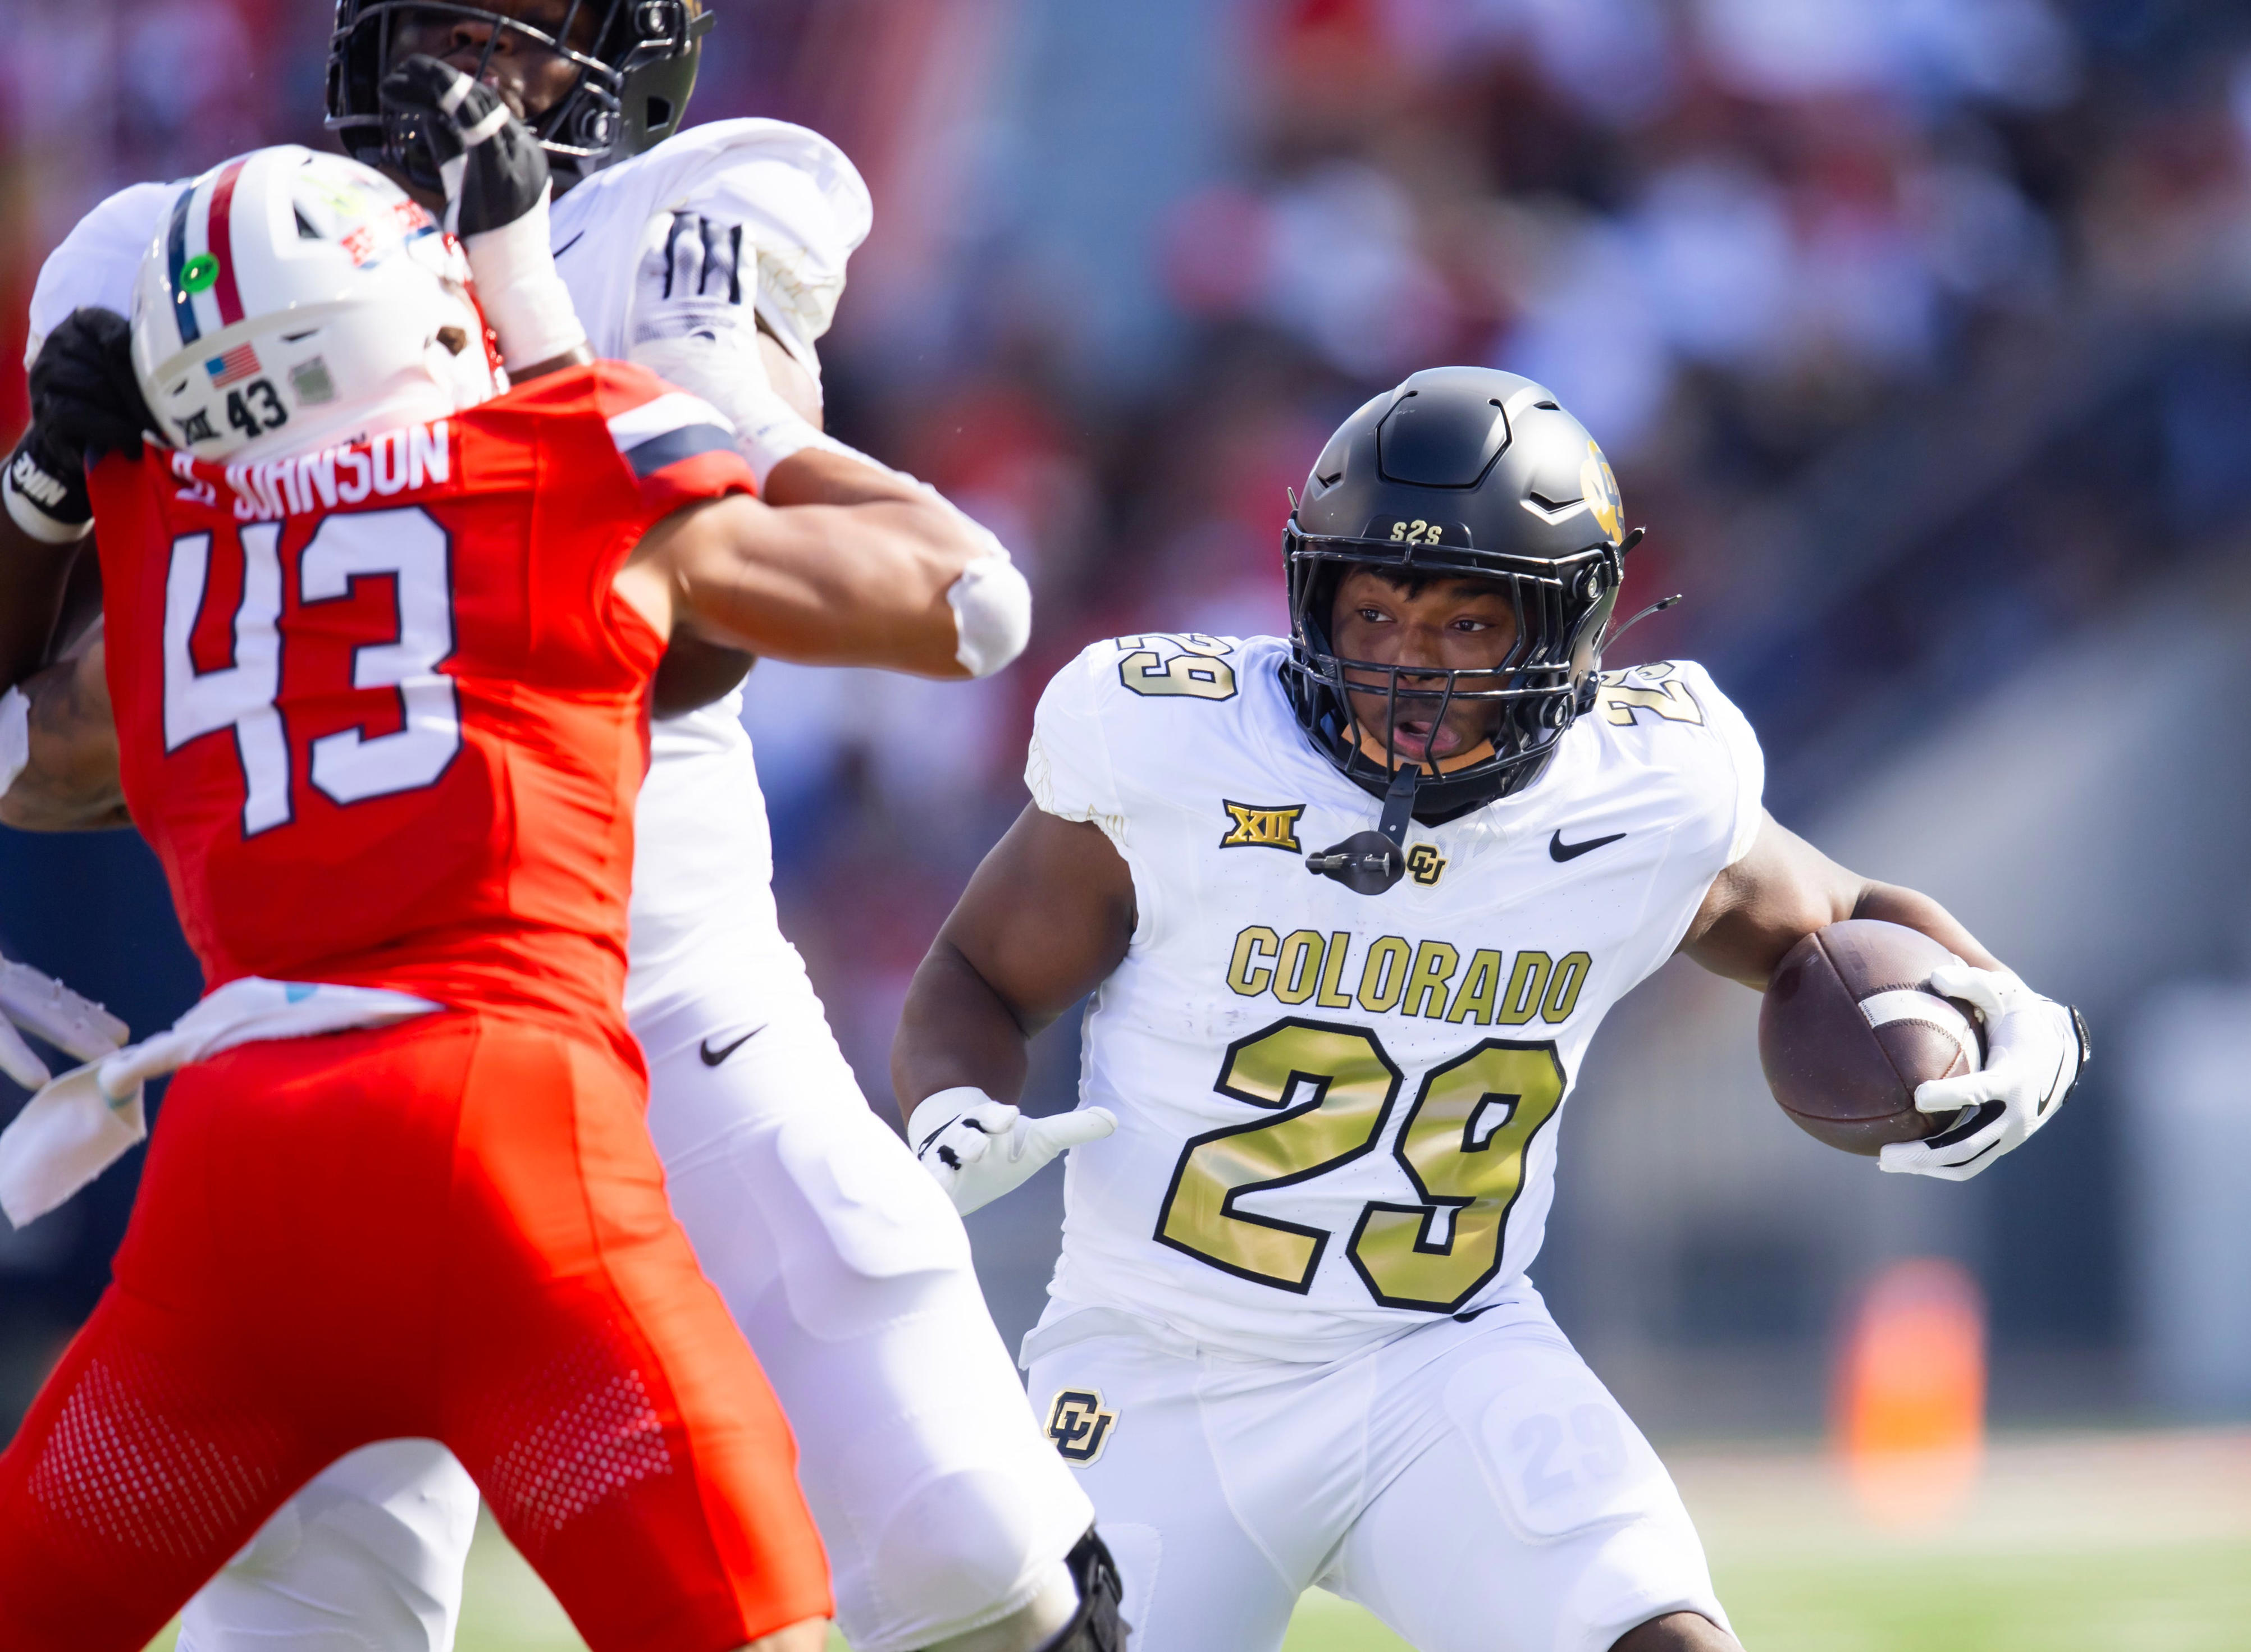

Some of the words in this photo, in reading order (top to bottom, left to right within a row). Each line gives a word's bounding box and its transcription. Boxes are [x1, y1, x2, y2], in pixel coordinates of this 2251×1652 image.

[227, 377, 288, 439] 43
[13, 450, 67, 507] NIKE
[163, 504, 464, 842] 43
[1116, 633, 1238, 702] 29
[1221, 801, 1305, 853] XII
[1406, 844, 1448, 886] CU
[1226, 926, 1592, 1026] COLORADO
[1153, 1016, 1567, 1314] 29
[1047, 1390, 1112, 1461] CU
[1512, 1402, 1630, 1505] 29
